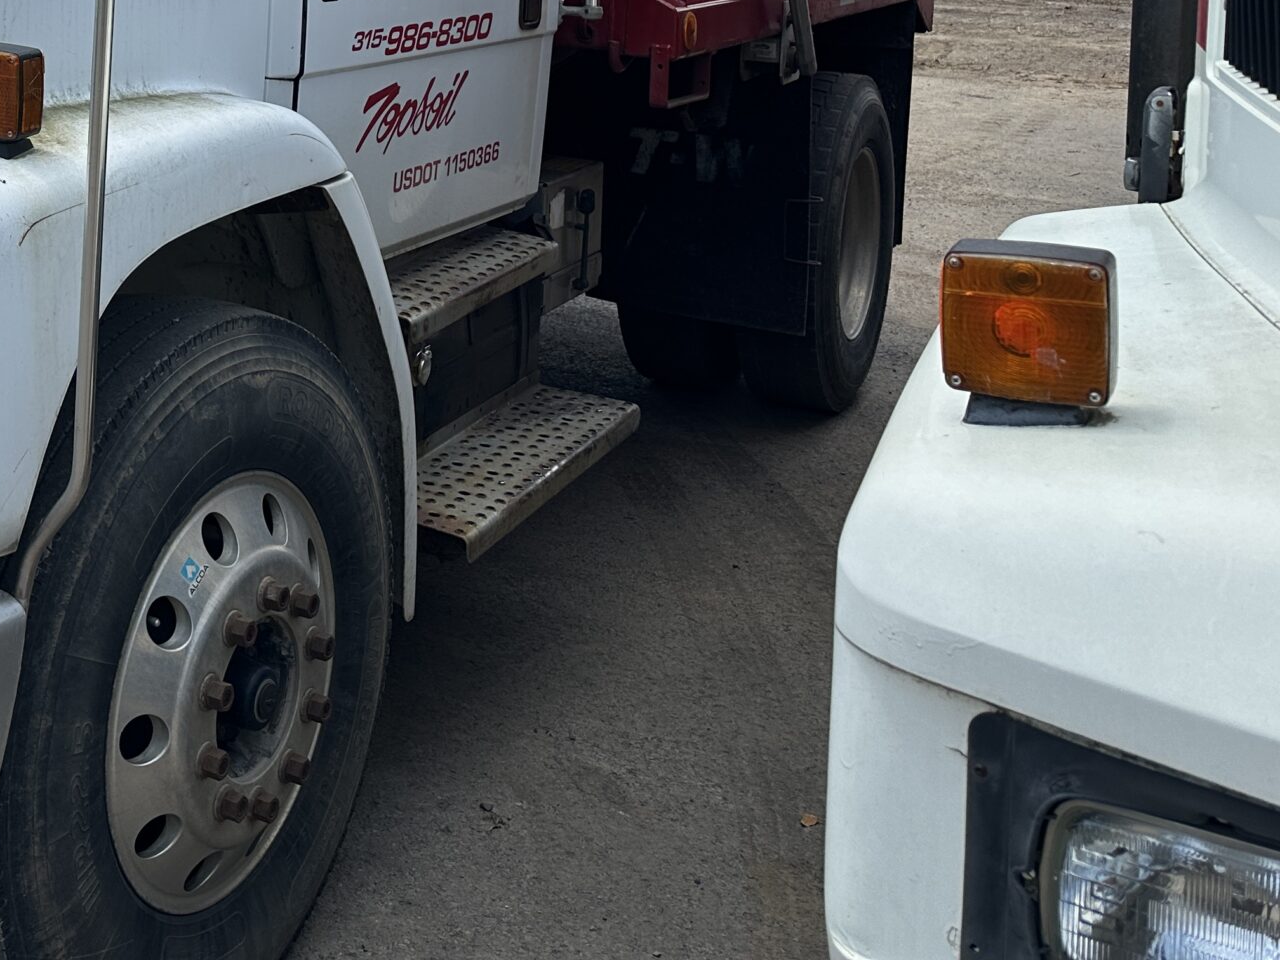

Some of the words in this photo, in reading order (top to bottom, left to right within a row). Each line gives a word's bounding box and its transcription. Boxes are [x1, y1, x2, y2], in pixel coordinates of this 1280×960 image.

[351, 12, 493, 56] 315-986-8300
[355, 70, 470, 155] Topsoil
[393, 160, 442, 193] USDOT
[444, 141, 500, 177] 1150366
[190, 565, 209, 595] ALCOA
